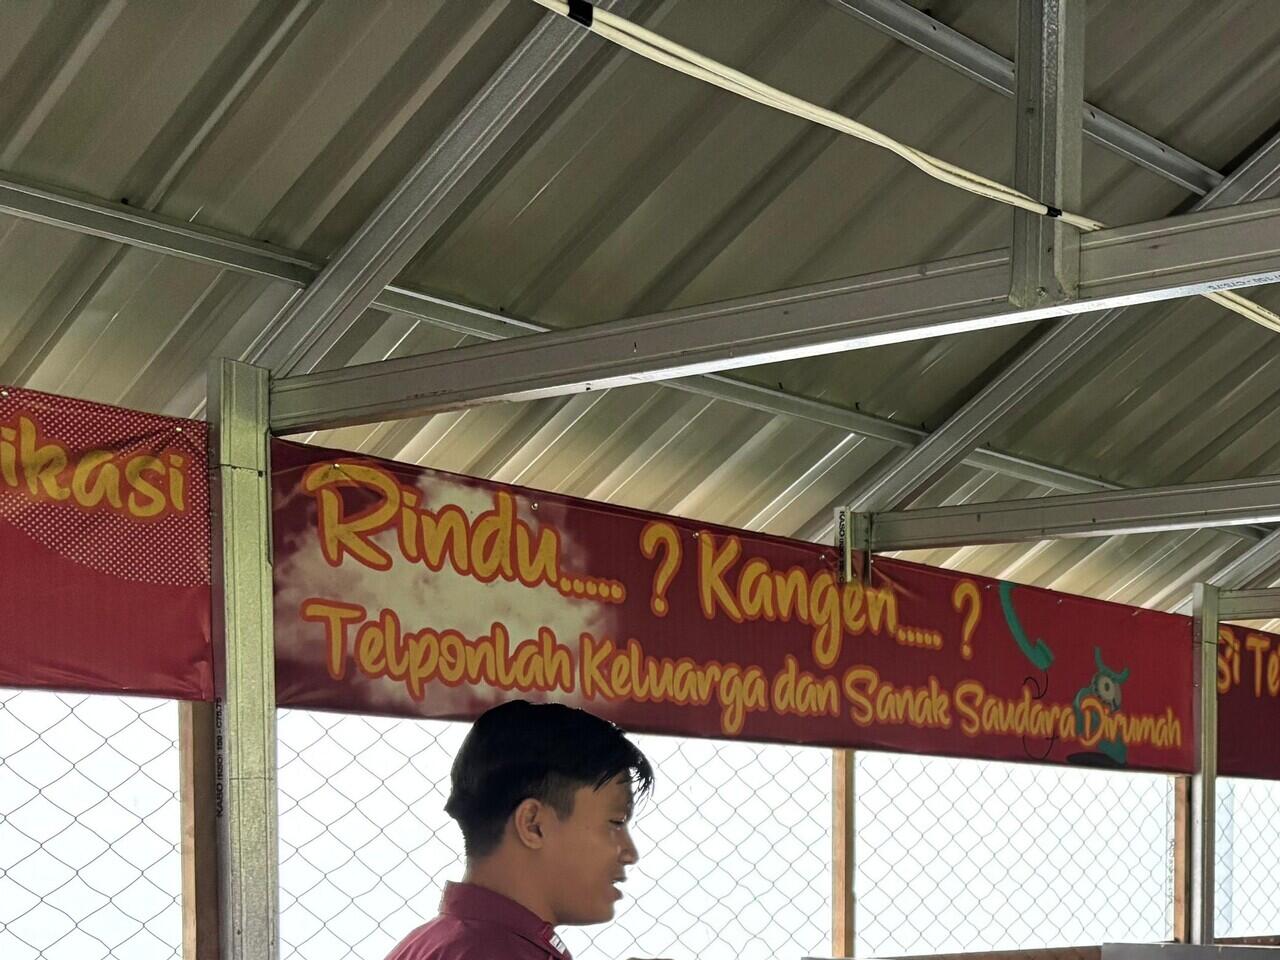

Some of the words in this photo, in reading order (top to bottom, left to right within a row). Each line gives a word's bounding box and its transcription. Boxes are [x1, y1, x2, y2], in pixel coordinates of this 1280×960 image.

[640, 520, 682, 617] ?
[953, 578, 984, 659] ?
[302, 600, 572, 700] Telponlah
[579, 632, 767, 735] Keluarga
[772, 655, 839, 719] dan
[845, 665, 951, 728] Sanak
[955, 682, 1076, 740] Saudara
[1078, 697, 1182, 751] Dirumah
